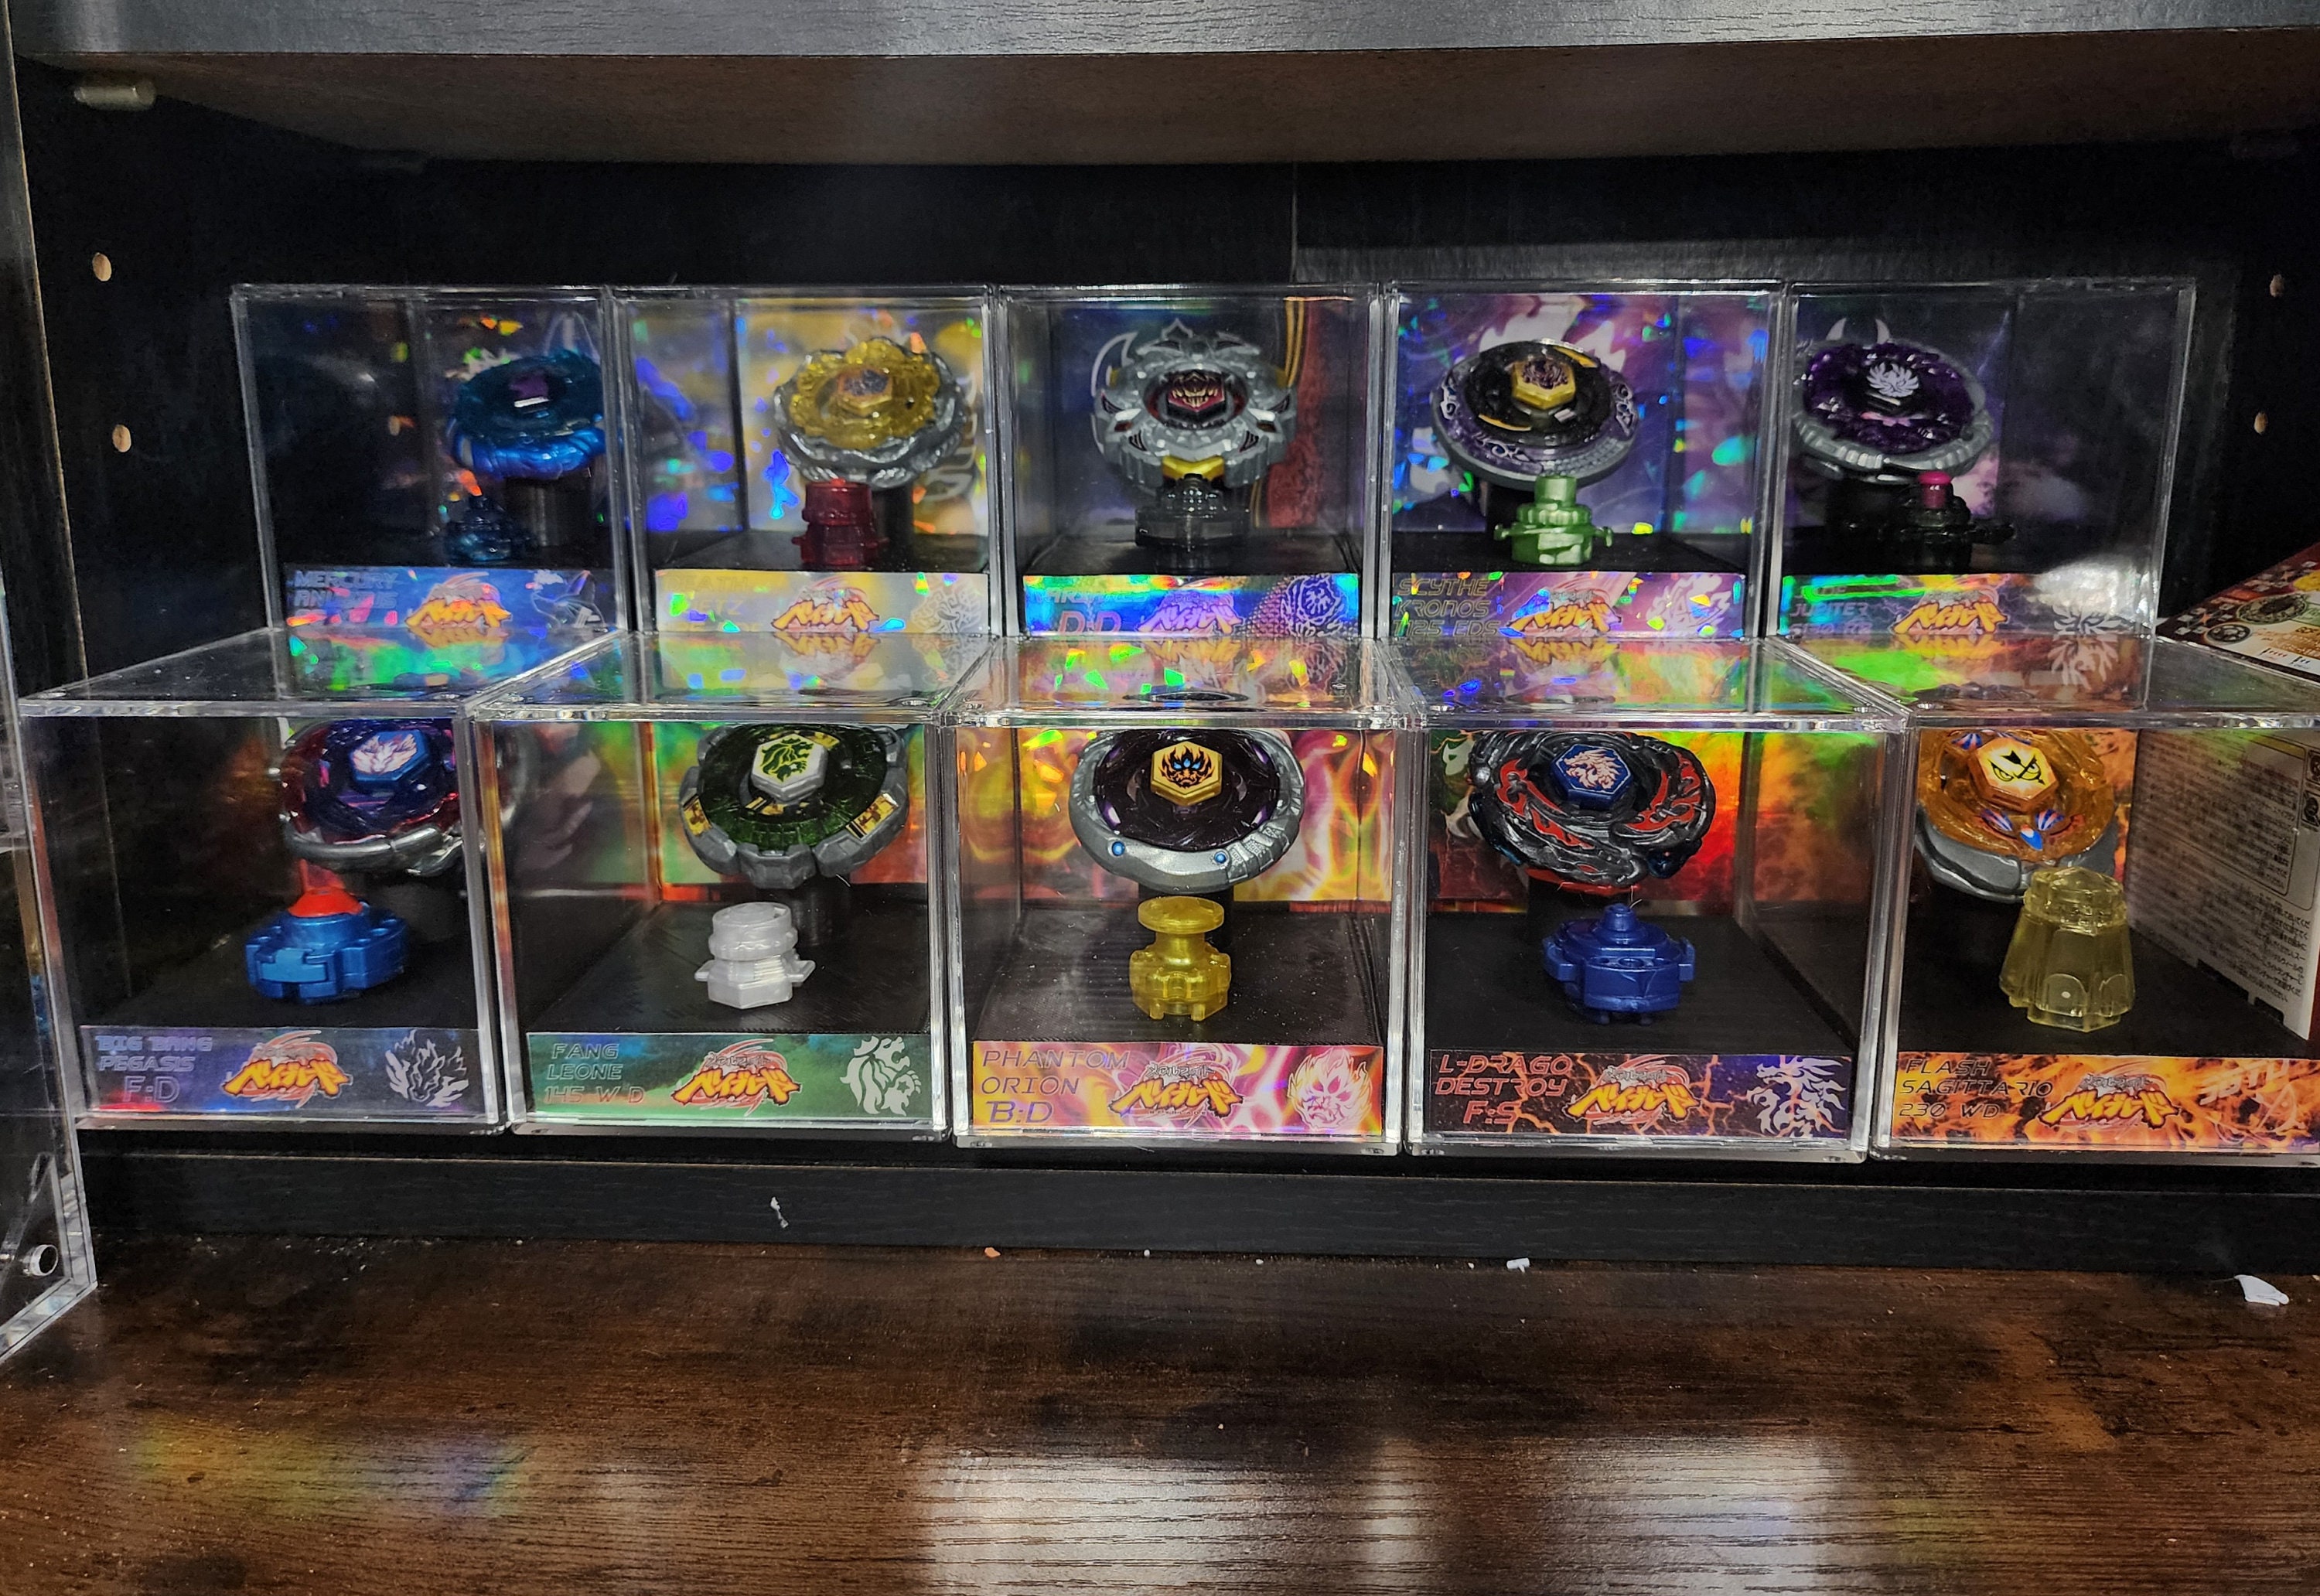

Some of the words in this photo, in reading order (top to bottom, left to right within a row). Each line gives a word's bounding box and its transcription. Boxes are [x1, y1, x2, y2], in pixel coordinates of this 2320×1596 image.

[1397, 578, 1489, 596] SCYTHE
[1395, 599, 1491, 618] KRONOS
[1789, 602, 1870, 617] JUPITER
[95, 1035, 142, 1051] BIG
[148, 1036, 213, 1052] BANG
[551, 1043, 619, 1059] FANG
[98, 1055, 196, 1072] PEGASIS
[982, 1049, 1130, 1069] PHANTOM
[1439, 1055, 1573, 1075] L-DRAGO
[1905, 1059, 1991, 1076] FLASH
[547, 1063, 623, 1080] LEONE
[122, 1076, 179, 1103] F:D
[981, 1076, 1080, 1095] ORION
[1435, 1077, 1568, 1096] DESTROY
[1899, 1079, 2053, 1097] SAGITTARIO
[544, 1086, 585, 1104] 145
[985, 1100, 1053, 1124] B:D
[1463, 1100, 1521, 1124] F:S
[1899, 1103, 1946, 1117] 230
[1960, 1103, 2001, 1119] WD
